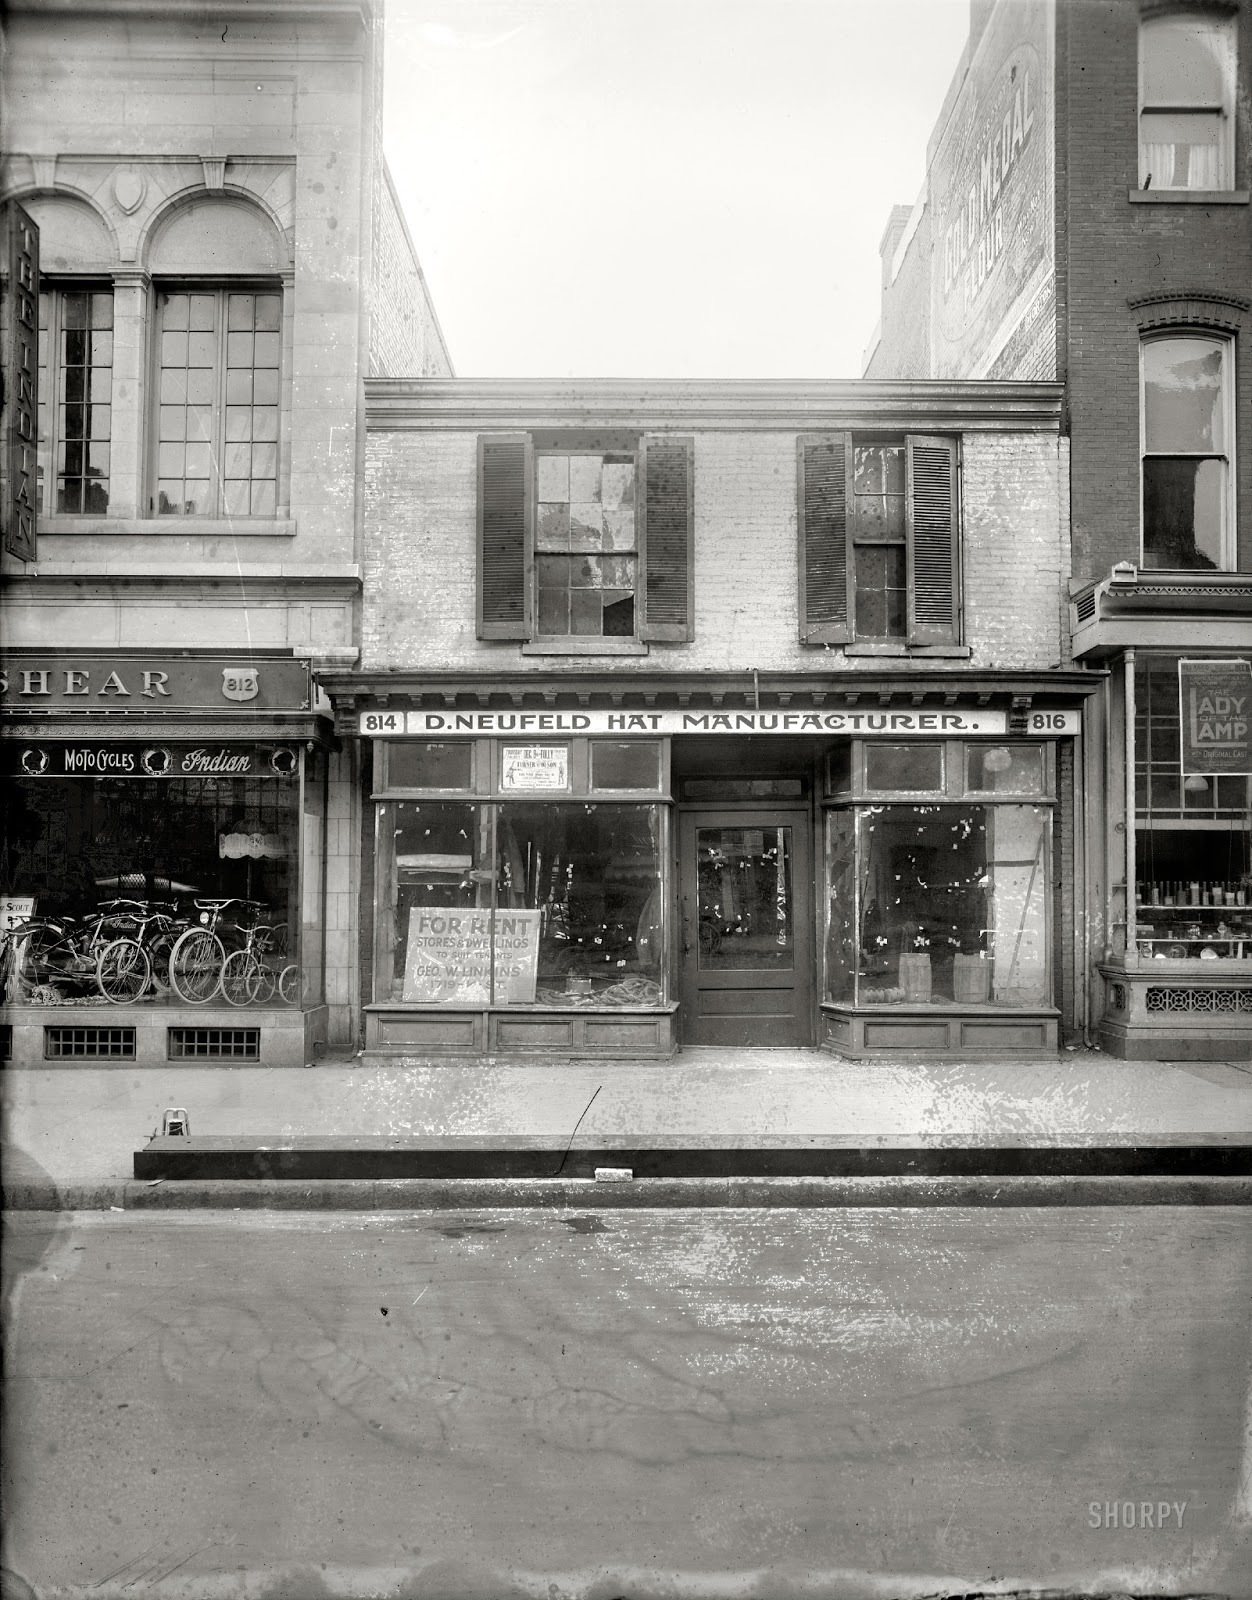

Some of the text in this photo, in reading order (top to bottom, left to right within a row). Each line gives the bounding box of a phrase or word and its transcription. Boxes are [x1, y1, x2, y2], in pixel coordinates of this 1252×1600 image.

[944, 182, 976, 296] GOLD
[980, 69, 1034, 226] MEDAL
[963, 204, 1003, 316] FLOUR
[15, 341, 35, 546] INDIAN
[226, 677, 254, 692] 812
[366, 714, 397, 731] 814
[608, 714, 663, 730] HAT
[682, 714, 980, 730] MANUFACTURER.
[1032, 713, 1067, 730] 816
[181, 748, 252, 772] Indian
[418, 916, 532, 936] FOR RENT
[465, 937, 529, 949] DWELINGS
[436, 951, 448, 959] TO
[451, 951, 472, 959] SUIT
